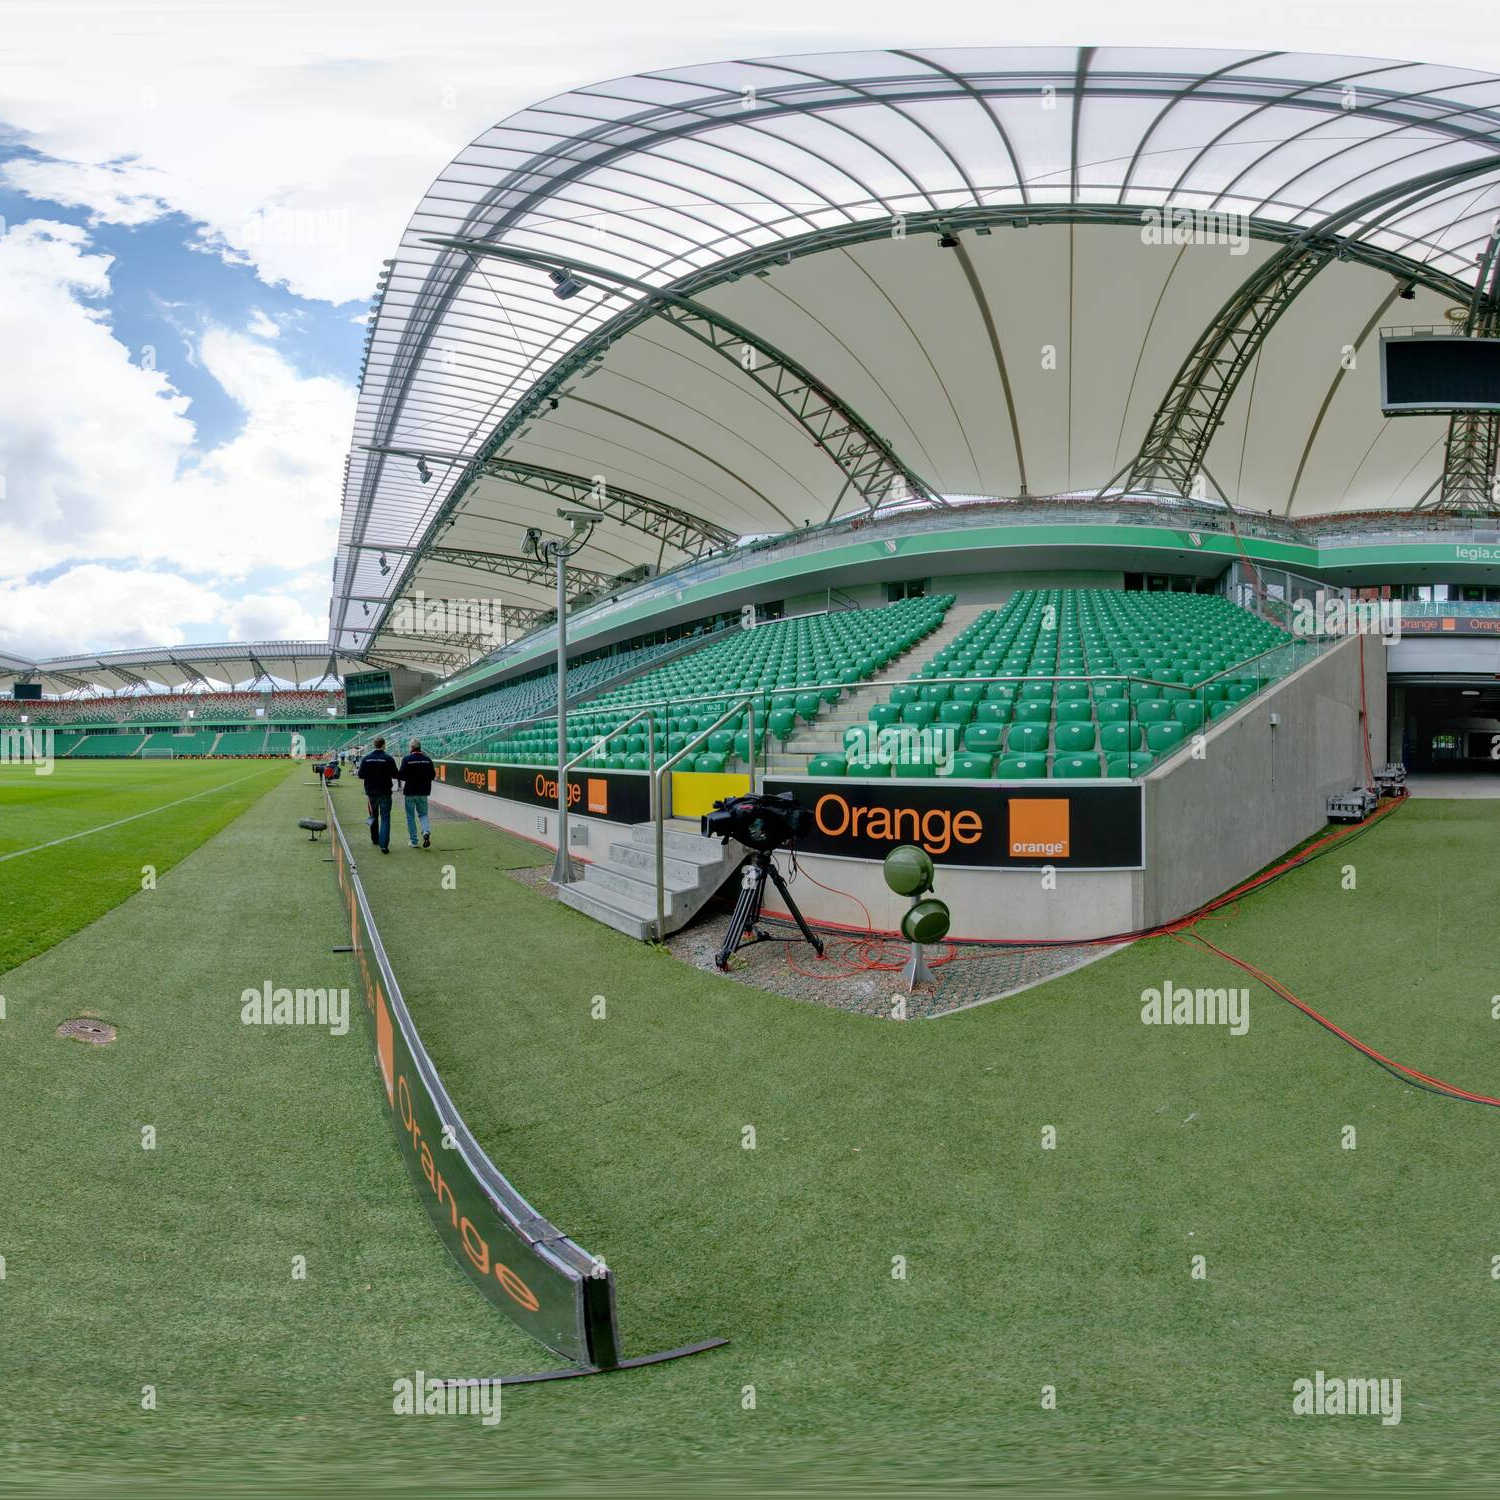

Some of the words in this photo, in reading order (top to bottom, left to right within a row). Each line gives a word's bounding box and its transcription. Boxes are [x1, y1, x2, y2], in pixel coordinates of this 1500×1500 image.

[463, 767, 486, 789] Orange
[813, 793, 984, 855] Orange
[398, 1074, 541, 1312] Orange
